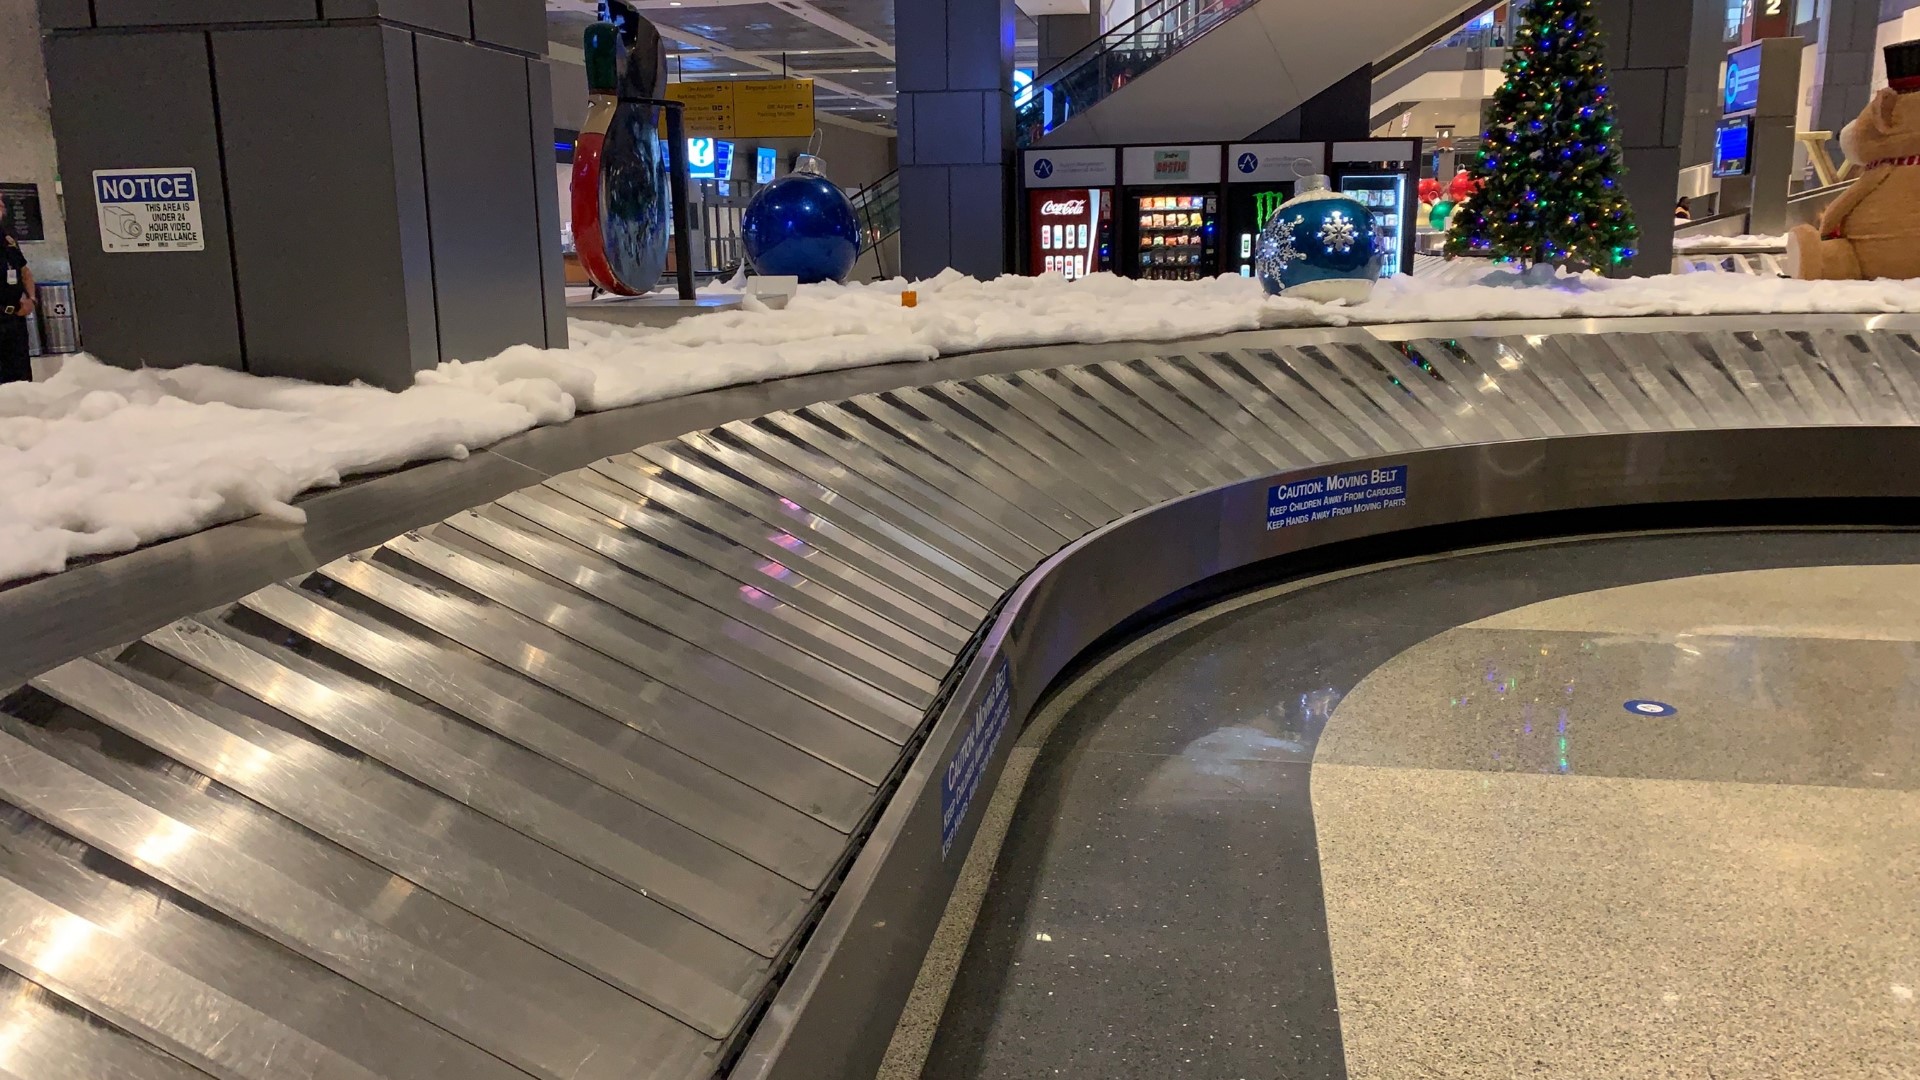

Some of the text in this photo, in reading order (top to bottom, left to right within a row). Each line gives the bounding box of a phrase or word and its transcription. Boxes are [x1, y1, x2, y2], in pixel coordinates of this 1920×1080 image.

[1765, 0, 1781, 15] 2
[102, 177, 189, 200] NOTICE
[145, 203, 190, 212] THIS AREA IS
[1041, 200, 1086, 215] Coca-Cola
[152, 213, 186, 222] UNDER 24
[148, 222, 191, 232] HOUR VIDEO
[145, 232, 198, 242] SURVEILLANCE
[1278, 469, 1398, 500] CAUTION: MOVING BELT
[1269, 485, 1404, 517] KEEP CHILDREN AWAY FROM CAROUSEL
[1266, 497, 1407, 531] KEEP HANDS AWAY FROM MOVING PARTS
